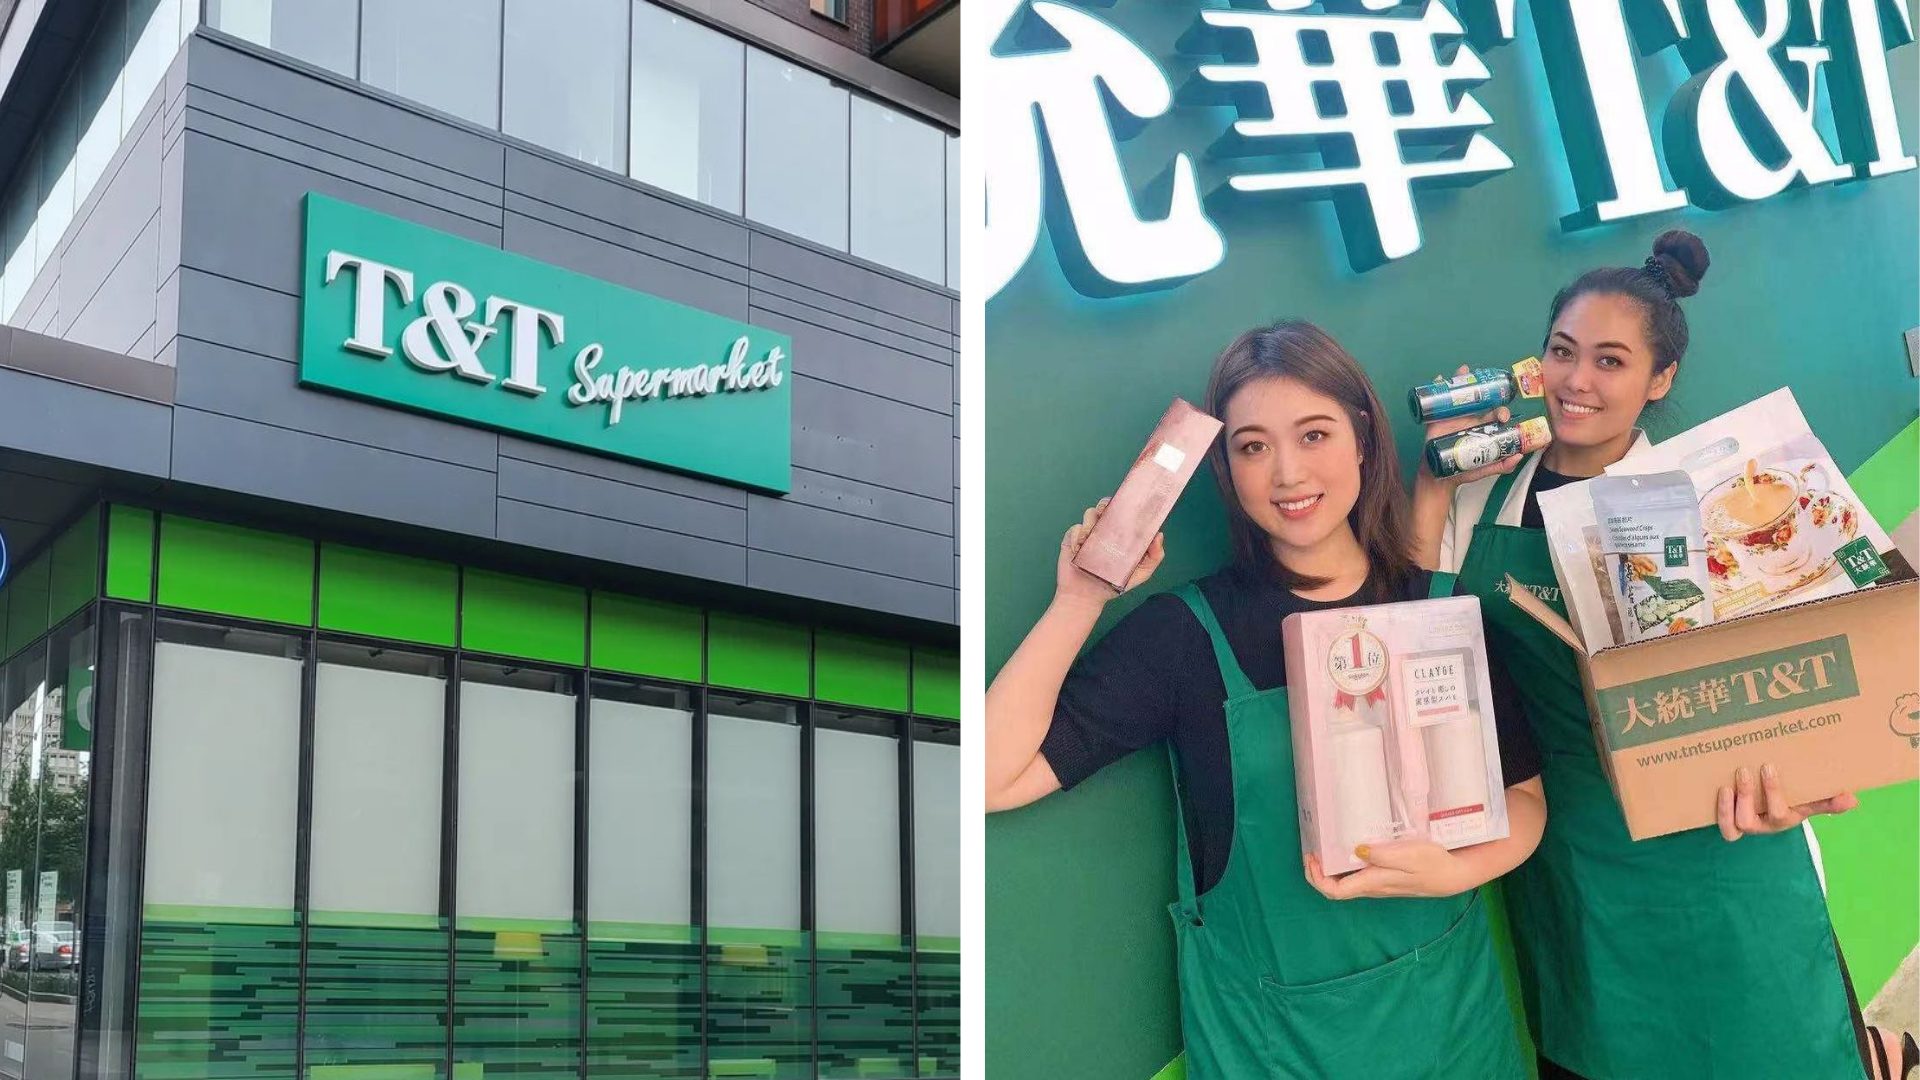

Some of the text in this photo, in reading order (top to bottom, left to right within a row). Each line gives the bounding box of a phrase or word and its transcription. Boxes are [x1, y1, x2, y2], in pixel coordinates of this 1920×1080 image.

[325, 250, 785, 425] T&T Supermarket
[1665, 545, 1685, 554] T&T
[1844, 547, 1874, 569] T&T
[1729, 651, 1836, 706] T&T
[1636, 711, 1842, 768] www.tntsupermarket.com
